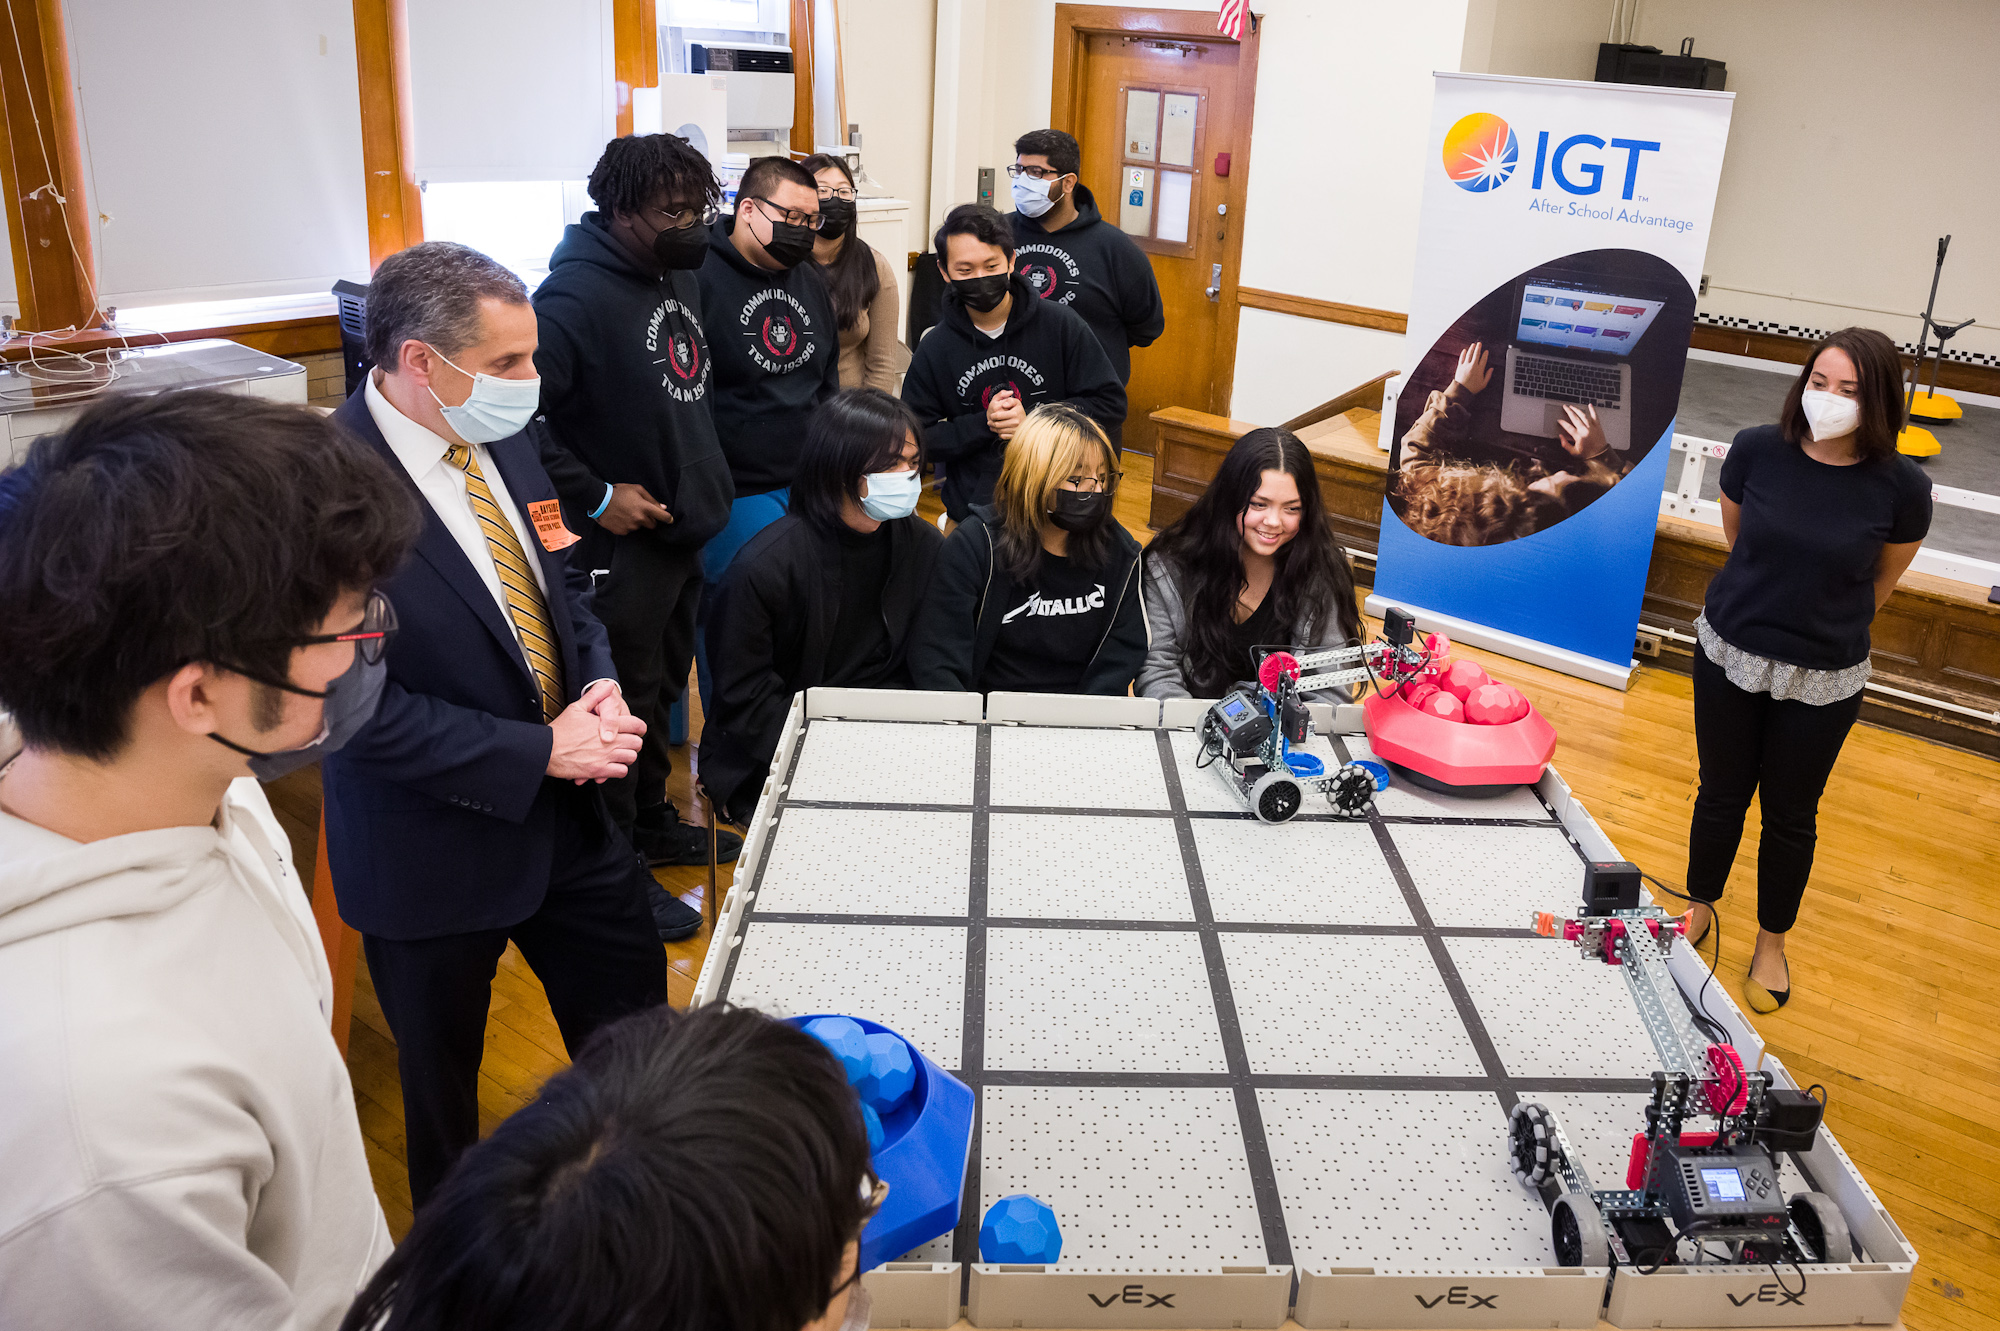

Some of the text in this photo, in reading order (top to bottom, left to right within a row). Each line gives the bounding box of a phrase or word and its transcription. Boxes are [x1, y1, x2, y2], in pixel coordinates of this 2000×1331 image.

[1531, 131, 1661, 201] IGT
[1528, 197, 1694, 233] After School Advantage
[1015, 244, 1080, 277] MMODORES
[747, 341, 816, 374] TEAM 19396
[661, 358, 712, 403] TEAM 1996
[956, 354, 1045, 397] COMMODORES
[1087, 1284, 1176, 1308] VEX
[1413, 1286, 1499, 1309] VEX
[1726, 1283, 1807, 1307] VEX
